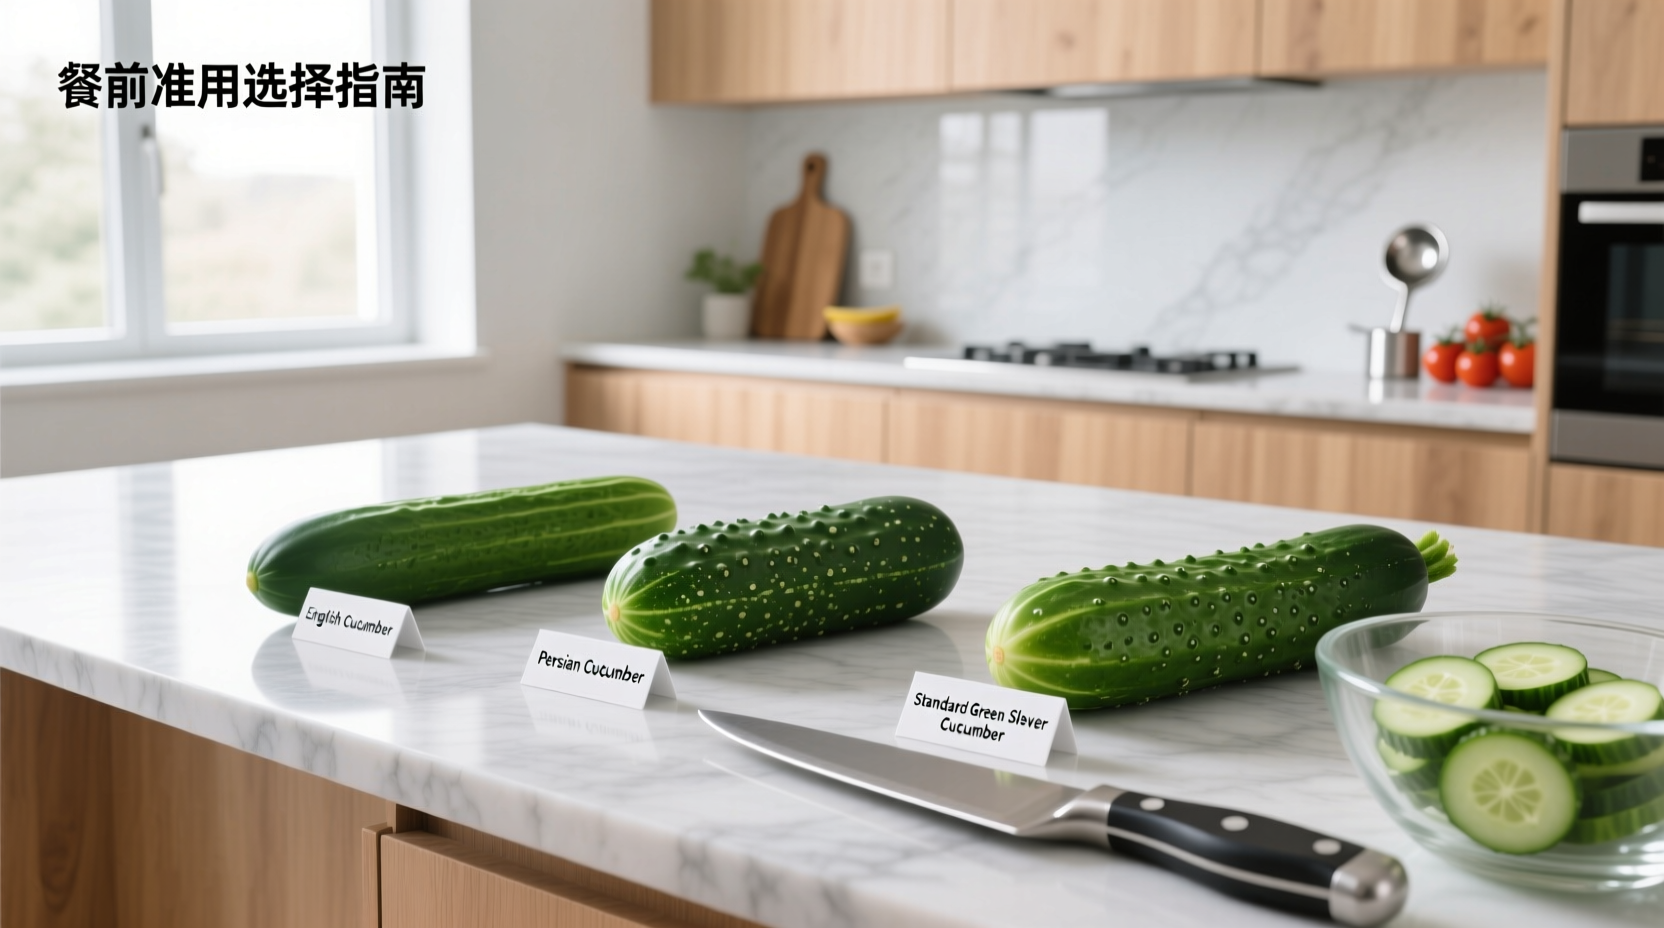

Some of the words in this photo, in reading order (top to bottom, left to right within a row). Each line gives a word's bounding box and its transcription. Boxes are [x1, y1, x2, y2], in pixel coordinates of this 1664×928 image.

[537, 650, 581, 673] Persian
[913, 692, 970, 715] Standard
[970, 702, 1005, 722] Green
[940, 717, 1006, 742] Cucumber
